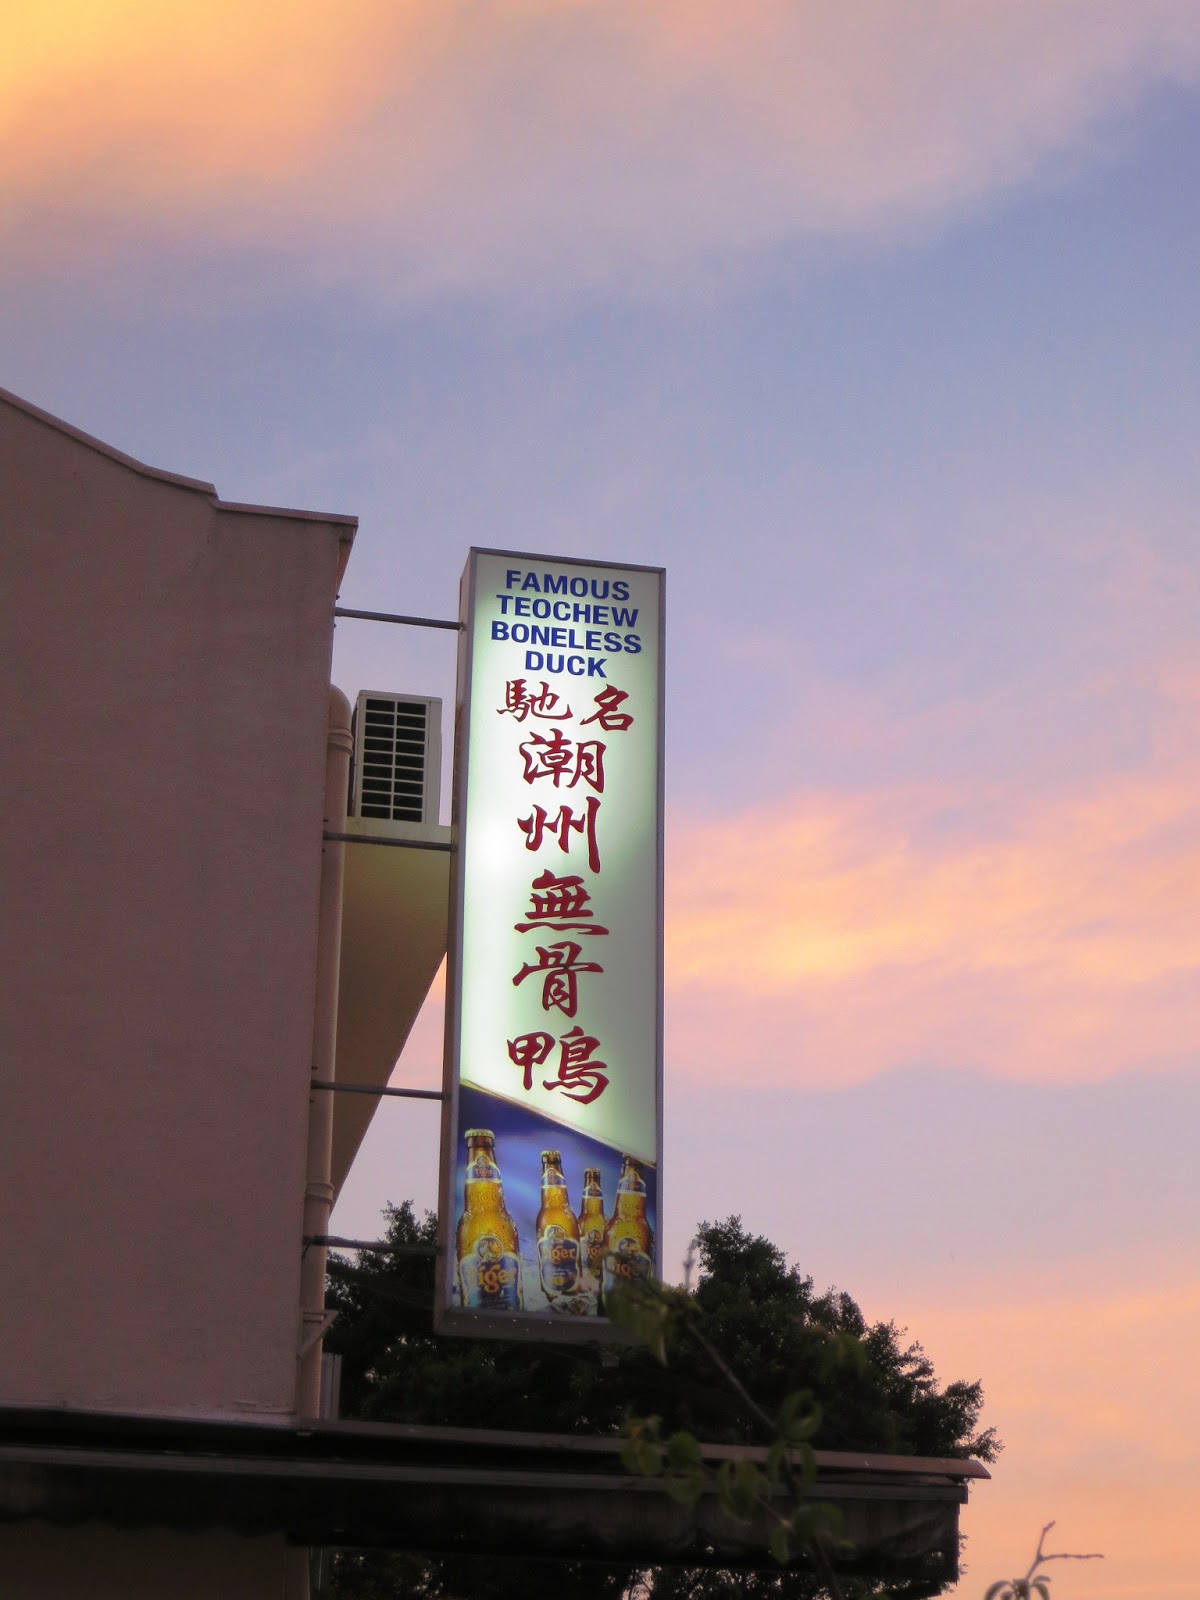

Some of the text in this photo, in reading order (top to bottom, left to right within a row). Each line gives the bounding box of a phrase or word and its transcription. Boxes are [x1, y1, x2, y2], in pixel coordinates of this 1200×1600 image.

[506, 569, 630, 602] FAMOUS
[496, 594, 639, 628] TEOCHEW
[491, 620, 642, 654] BONELESS
[525, 650, 608, 679] DUCK
